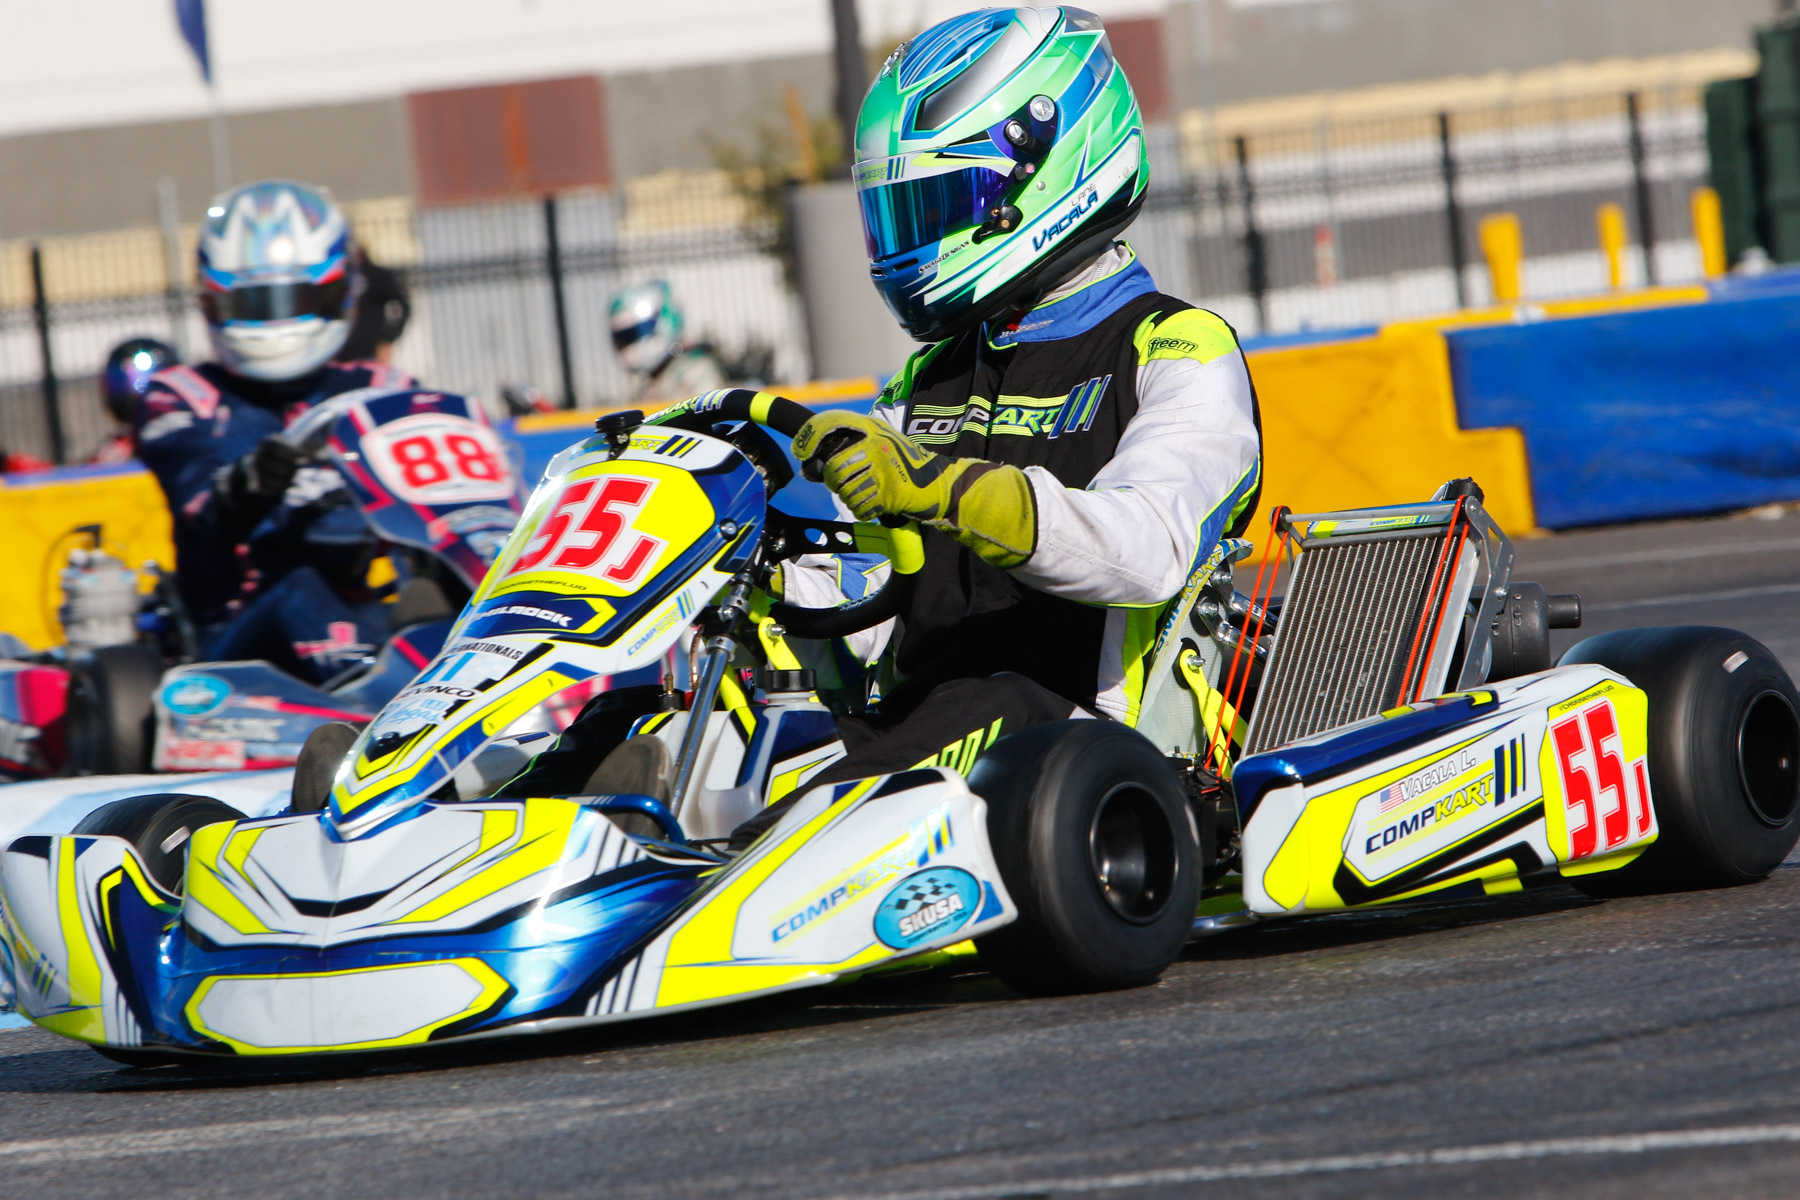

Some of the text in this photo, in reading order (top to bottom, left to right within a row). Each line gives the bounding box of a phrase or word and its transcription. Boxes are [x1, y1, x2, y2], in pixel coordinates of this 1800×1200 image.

[1032, 190, 1098, 252] VACALA
[1148, 337, 1197, 354] freem
[390, 433, 507, 488] 88
[1399, 761, 1457, 801] VACALA
[1366, 773, 1494, 855] COMPKART
[771, 845, 915, 943] COMPKART
[898, 893, 964, 937] SKUSA
